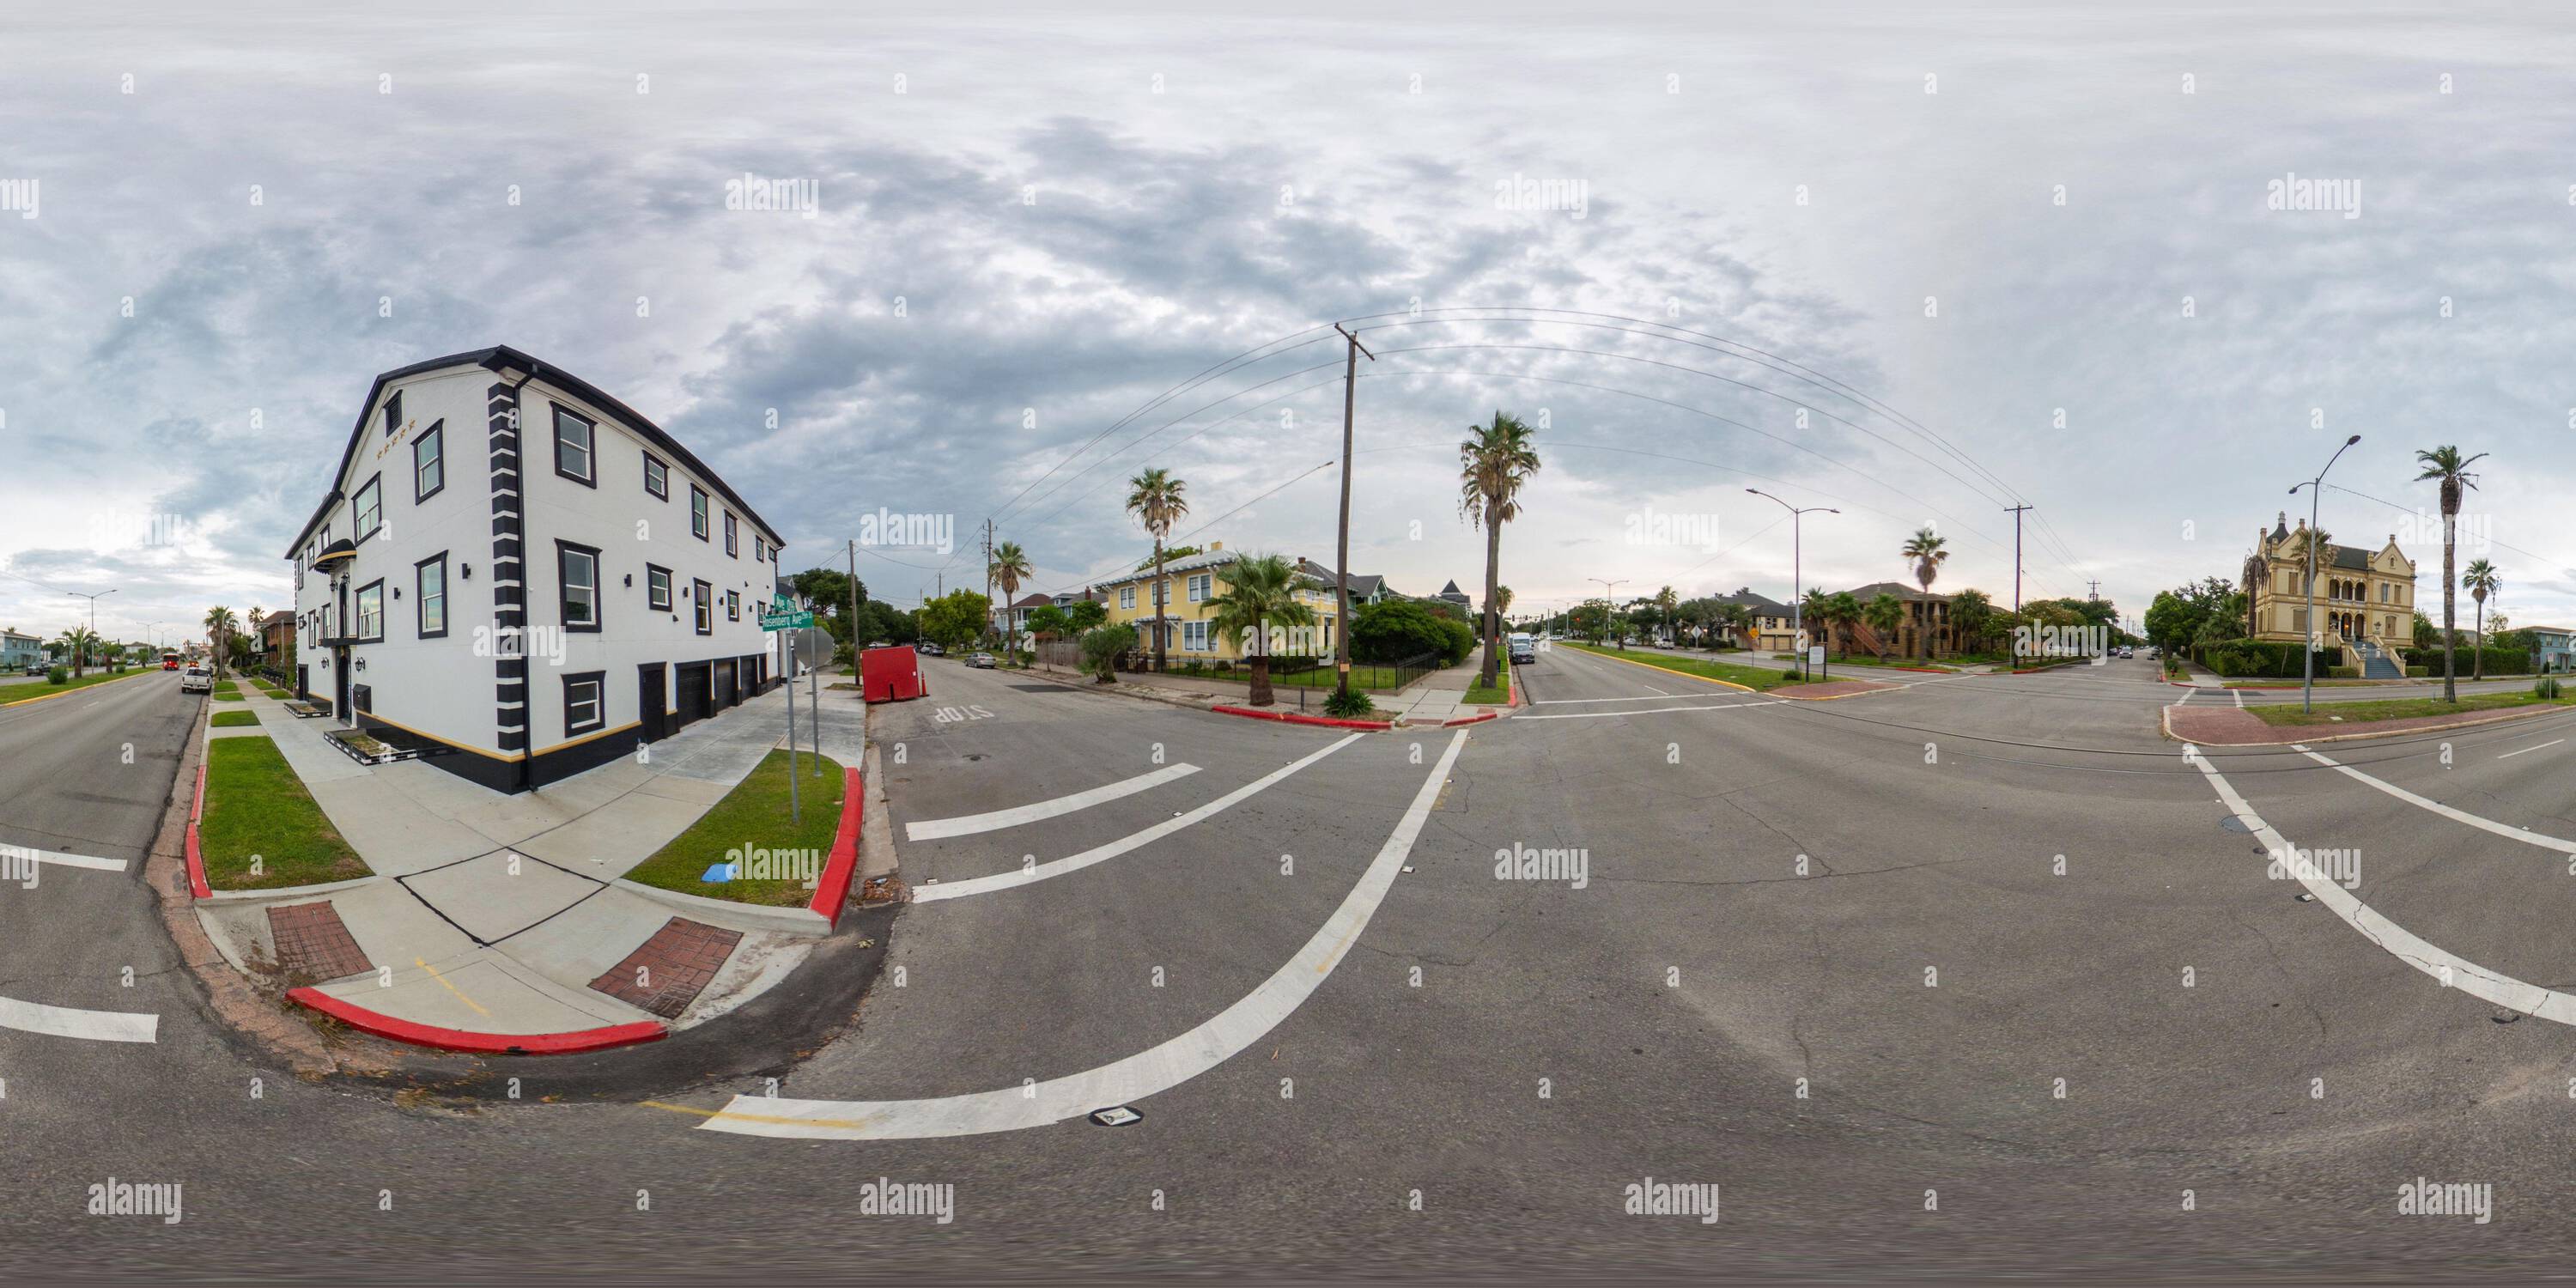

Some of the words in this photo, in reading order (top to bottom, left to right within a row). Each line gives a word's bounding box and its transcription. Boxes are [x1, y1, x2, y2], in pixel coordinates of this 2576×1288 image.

[763, 616, 790, 628] Rosenberg
[792, 614, 802, 625] Ave
[934, 705, 995, 723] STOP
